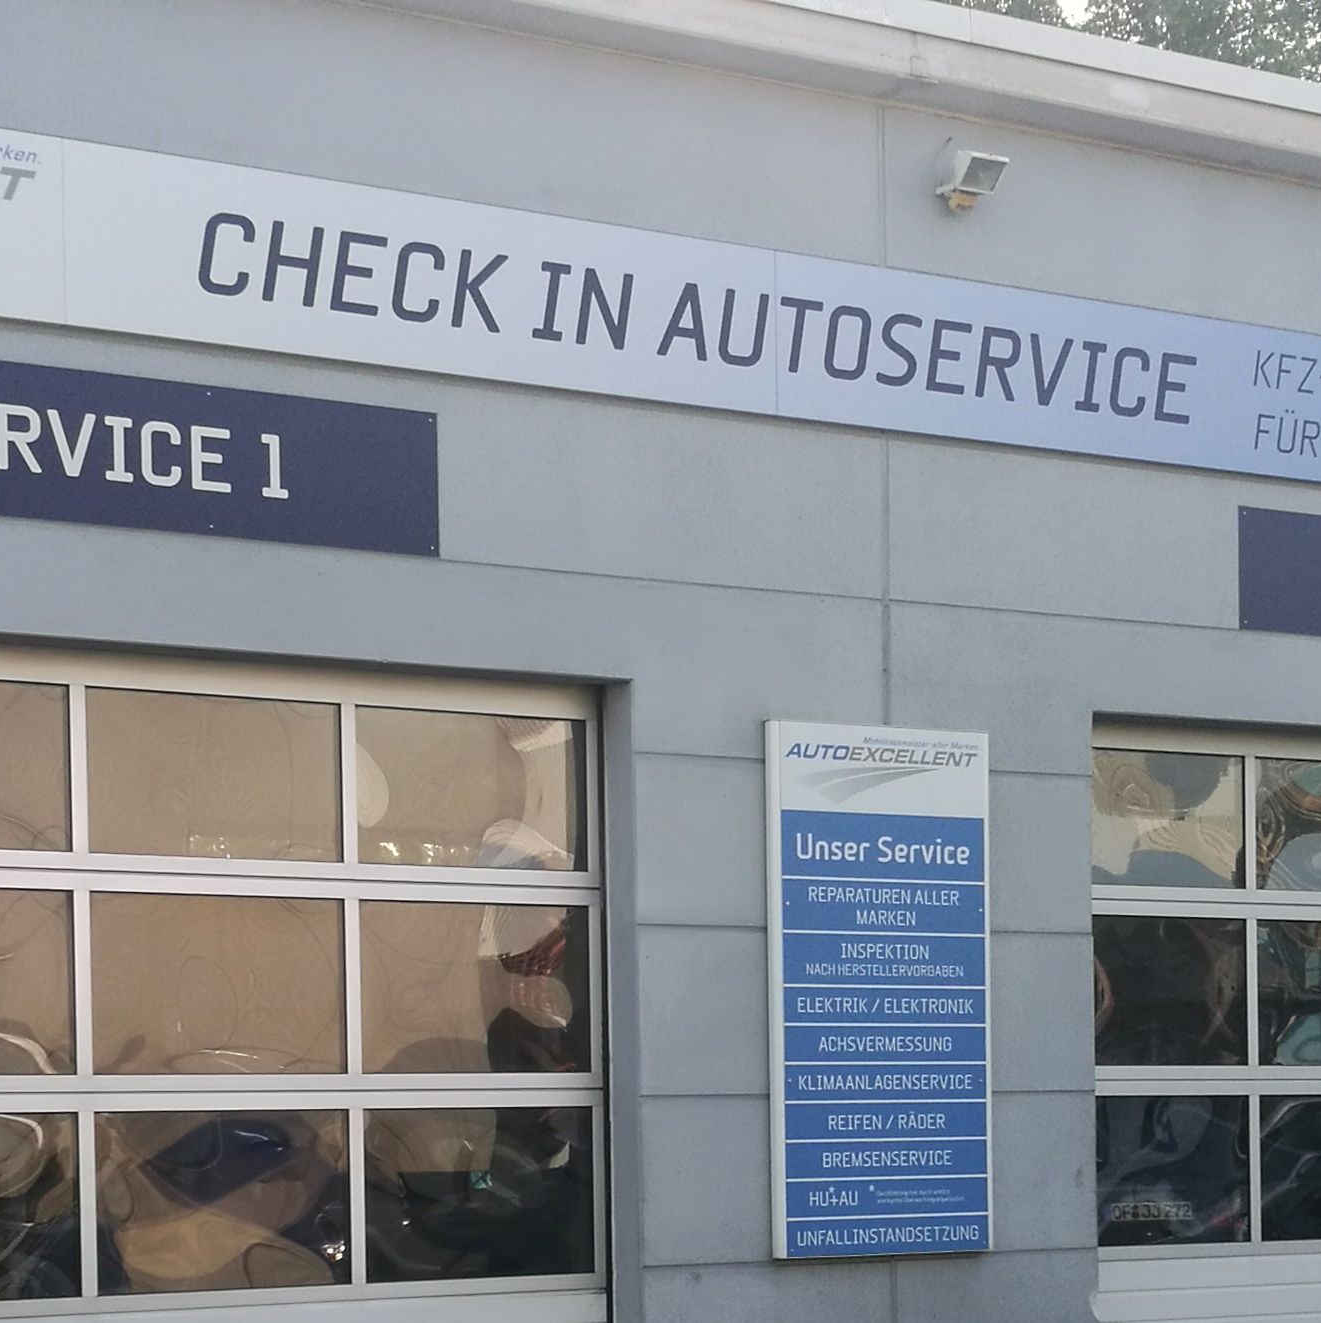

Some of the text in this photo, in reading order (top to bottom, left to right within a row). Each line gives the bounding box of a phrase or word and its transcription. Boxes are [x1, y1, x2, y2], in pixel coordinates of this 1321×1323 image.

[197, 212, 1198, 425] CHECK IN AUTOSERVICE
[1253, 410, 1321, 458] FÜR
[260, 433, 290, 499] 1
[785, 743, 978, 768] AUTOEXCELLENT
[796, 832, 970, 865] Unser Service
[808, 886, 959, 906] REPARATUREN ALLER
[856, 910, 916, 926] MARKEN
[840, 943, 929, 960] INSPEKTION
[805, 963, 964, 977] NACH HERSTELLERVORGABEN
[797, 997, 868, 1013] ELEKTRIK
[884, 998, 974, 1014] ELEKTRONIK
[818, 1036, 952, 1051] ACHSVERMESSUNG
[798, 1074, 973, 1090] KLIMAANLAGENSERVICE
[828, 1114, 882, 1130] REIFEN
[898, 1111, 946, 1129] RÄDER
[822, 1150, 952, 1167] BREMSENSERVICE
[797, 1225, 979, 1247] UNFALLINSTANDSETZUNG
